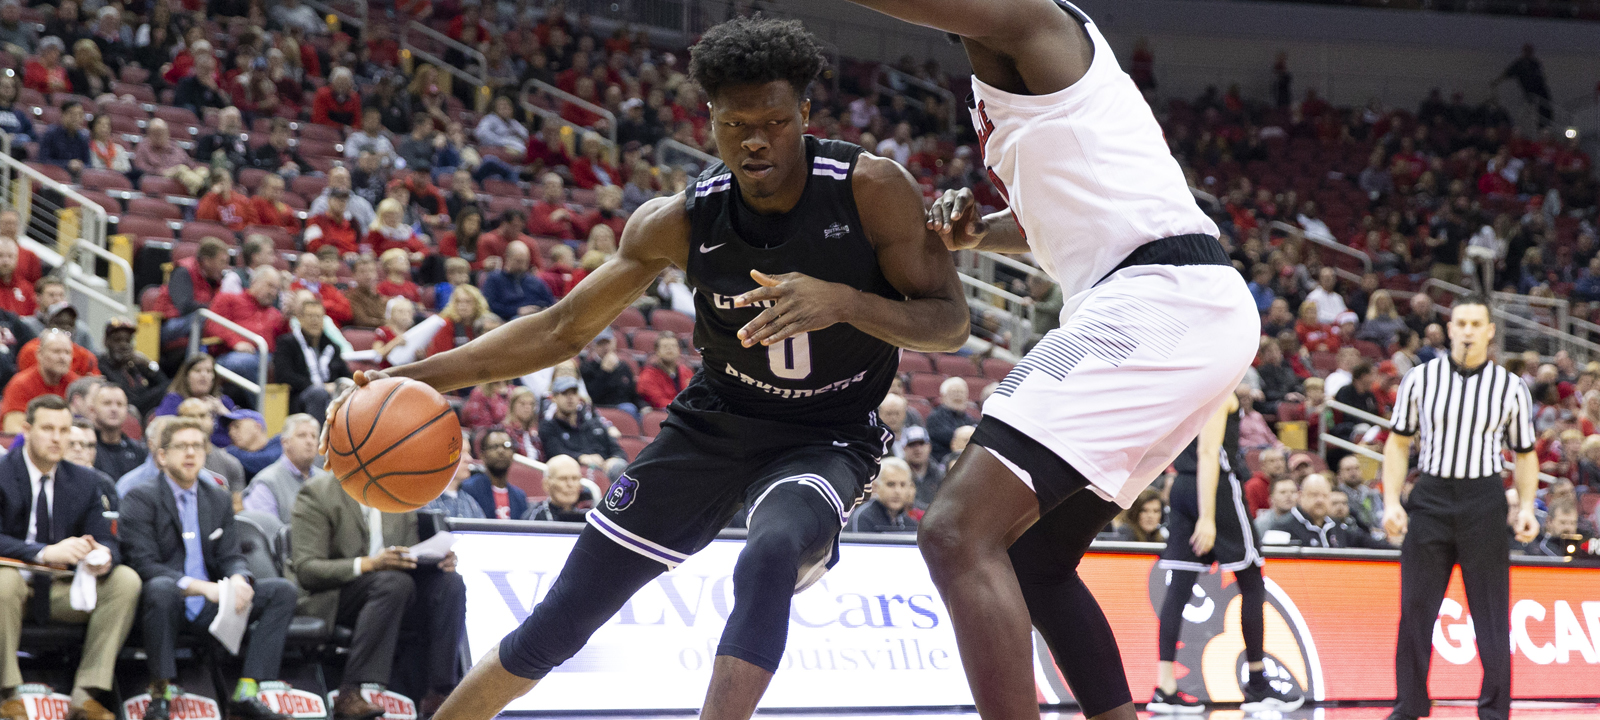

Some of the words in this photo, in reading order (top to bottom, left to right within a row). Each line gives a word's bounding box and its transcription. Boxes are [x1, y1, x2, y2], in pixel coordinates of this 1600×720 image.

[767, 331, 812, 380] 0
[480, 569, 734, 627] VLV
[790, 577, 939, 629] Cars
[784, 638, 951, 671] ouisville
